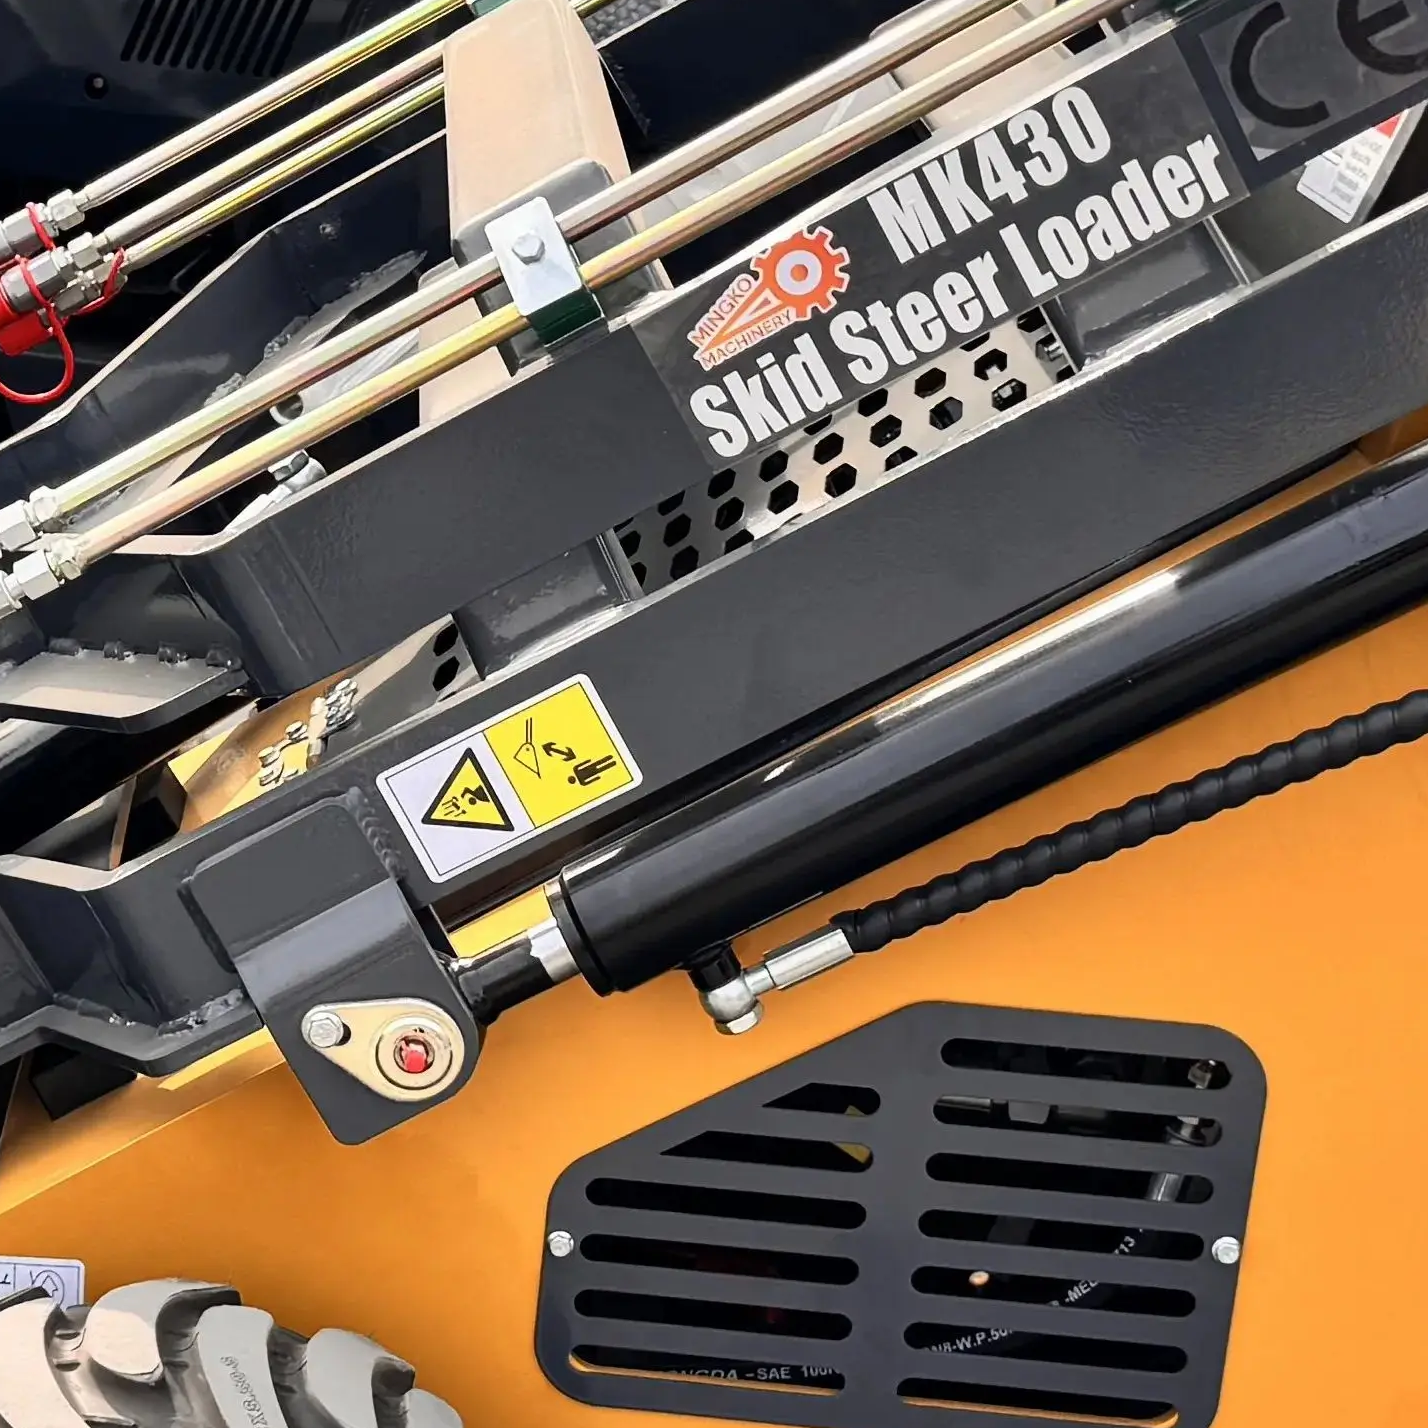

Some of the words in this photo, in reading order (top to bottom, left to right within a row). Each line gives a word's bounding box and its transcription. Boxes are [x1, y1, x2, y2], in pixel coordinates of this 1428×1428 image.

[866, 85, 1111, 264] MK430
[689, 332, 843, 458] Skid
[830, 251, 1009, 385] Steer
[999, 134, 1230, 297] Loader
[691, 276, 752, 346] MINGKO
[700, 309, 793, 369] MACHINERY
